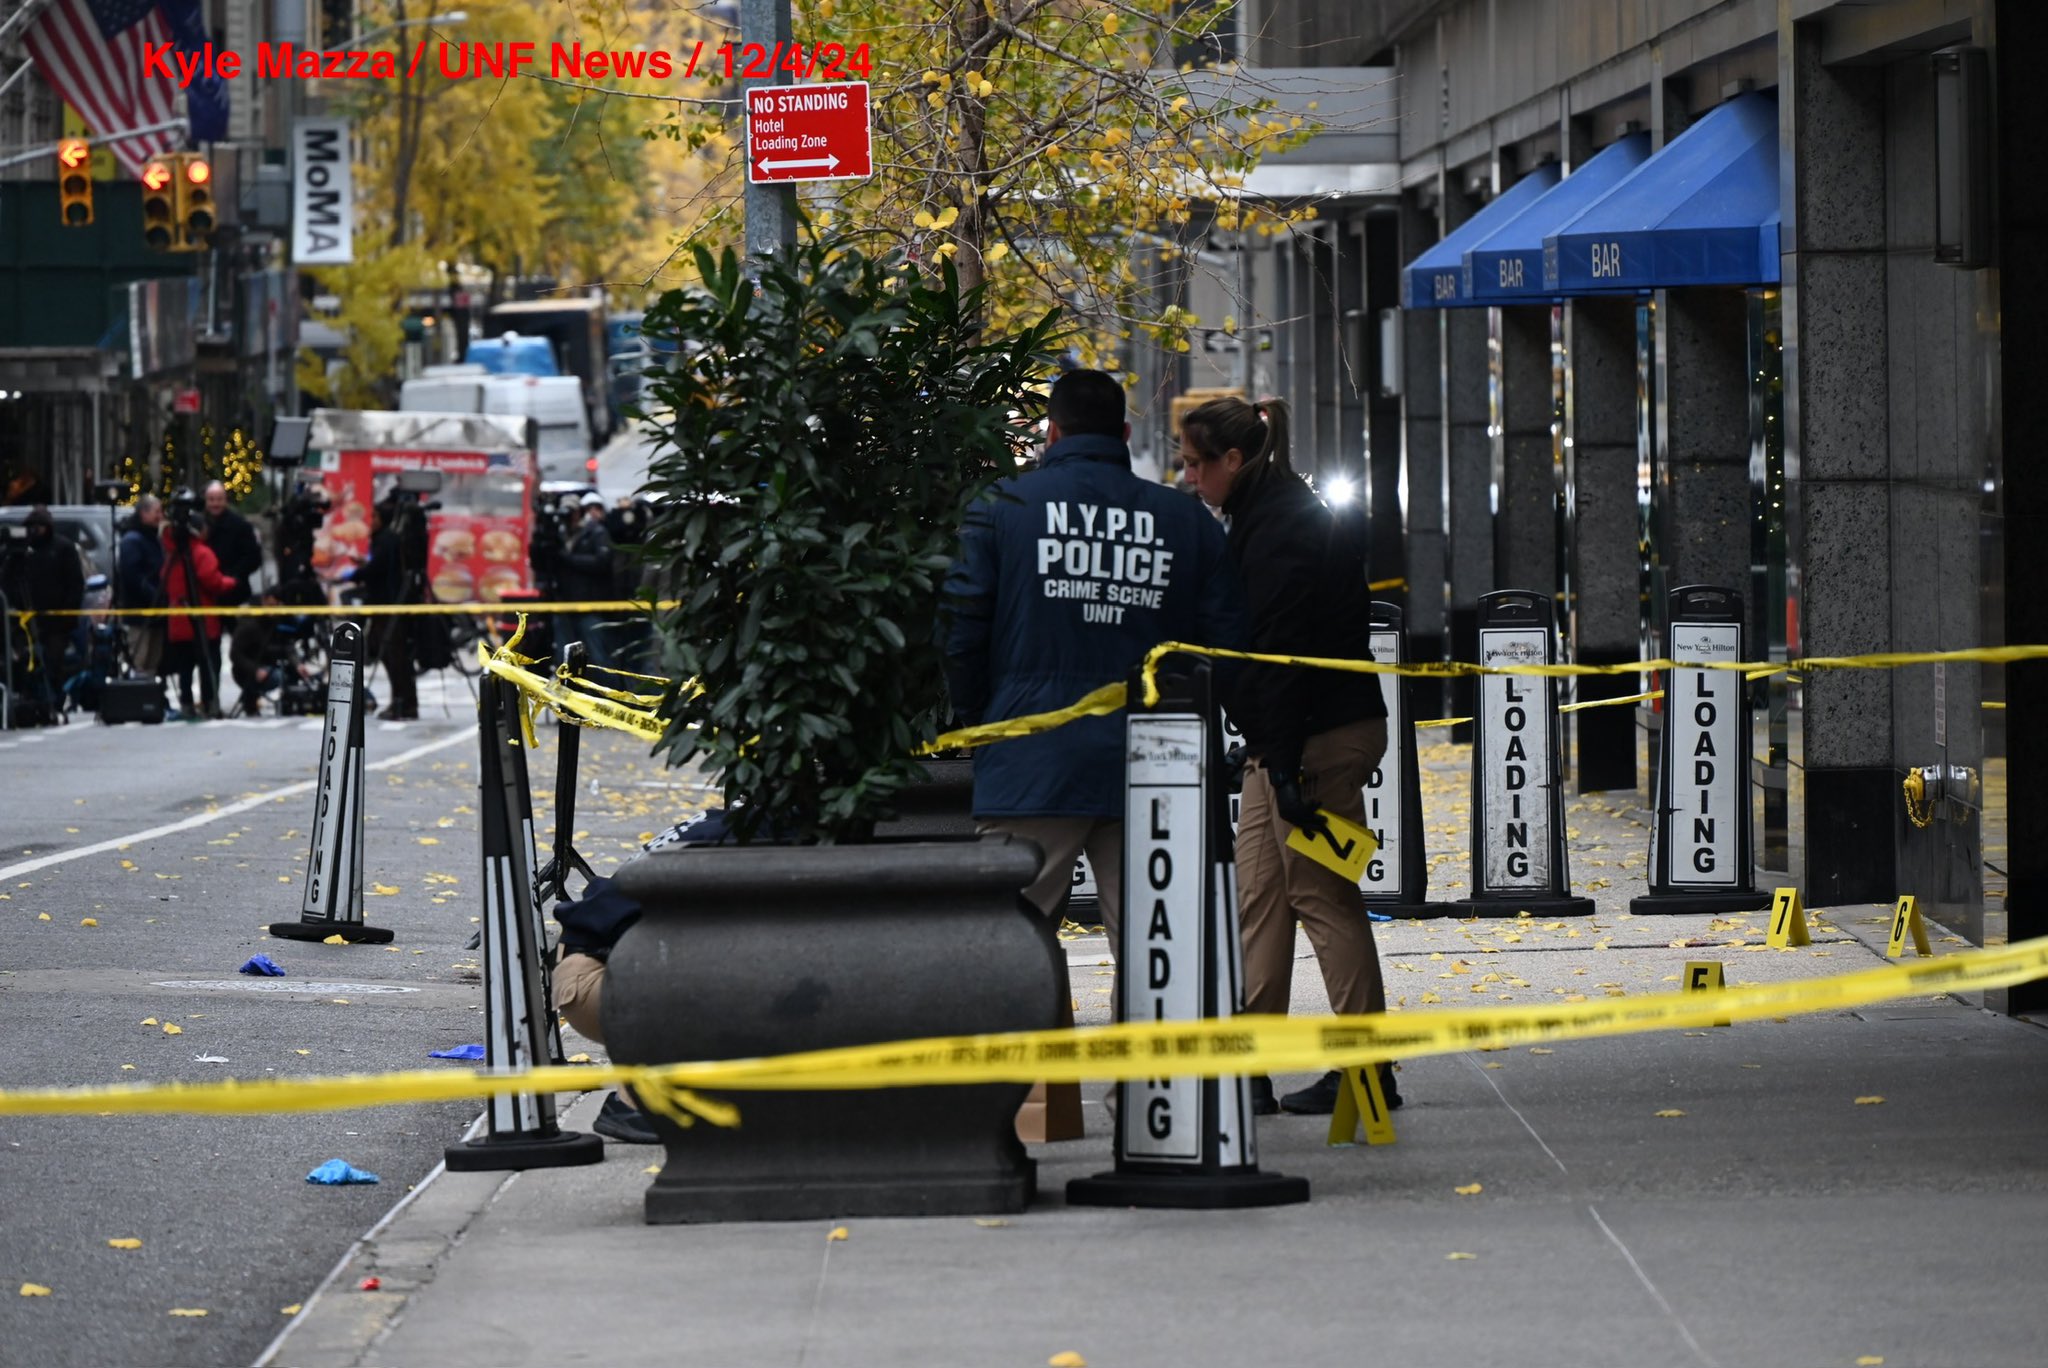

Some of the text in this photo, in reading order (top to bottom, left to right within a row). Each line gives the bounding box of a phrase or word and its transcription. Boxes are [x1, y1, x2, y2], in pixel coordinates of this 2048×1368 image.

[754, 93, 848, 113] NO STANDING
[755, 118, 784, 133] Hotel
[756, 135, 827, 151] Loading Zone
[304, 129, 340, 254] MoMA
[1500, 259, 1523, 287] BAR
[1591, 243, 1621, 277] BAR
[1434, 275, 1456, 300] BAR
[1046, 501, 1164, 546] N.Y.P.D.
[1038, 538, 1173, 586] POLICE
[1044, 579, 1163, 609] CRIME SCENE
[1083, 603, 1125, 624] UNIT
[1713, 644, 1735, 652] Hilton
[1505, 678, 1529, 877] LOADING
[1693, 672, 1717, 873] LOADING
[310, 708, 338, 904] LOADING
[1776, 896, 1791, 934] 7
[1894, 901, 1908, 941] 6
[1360, 1067, 1380, 1122] 1
